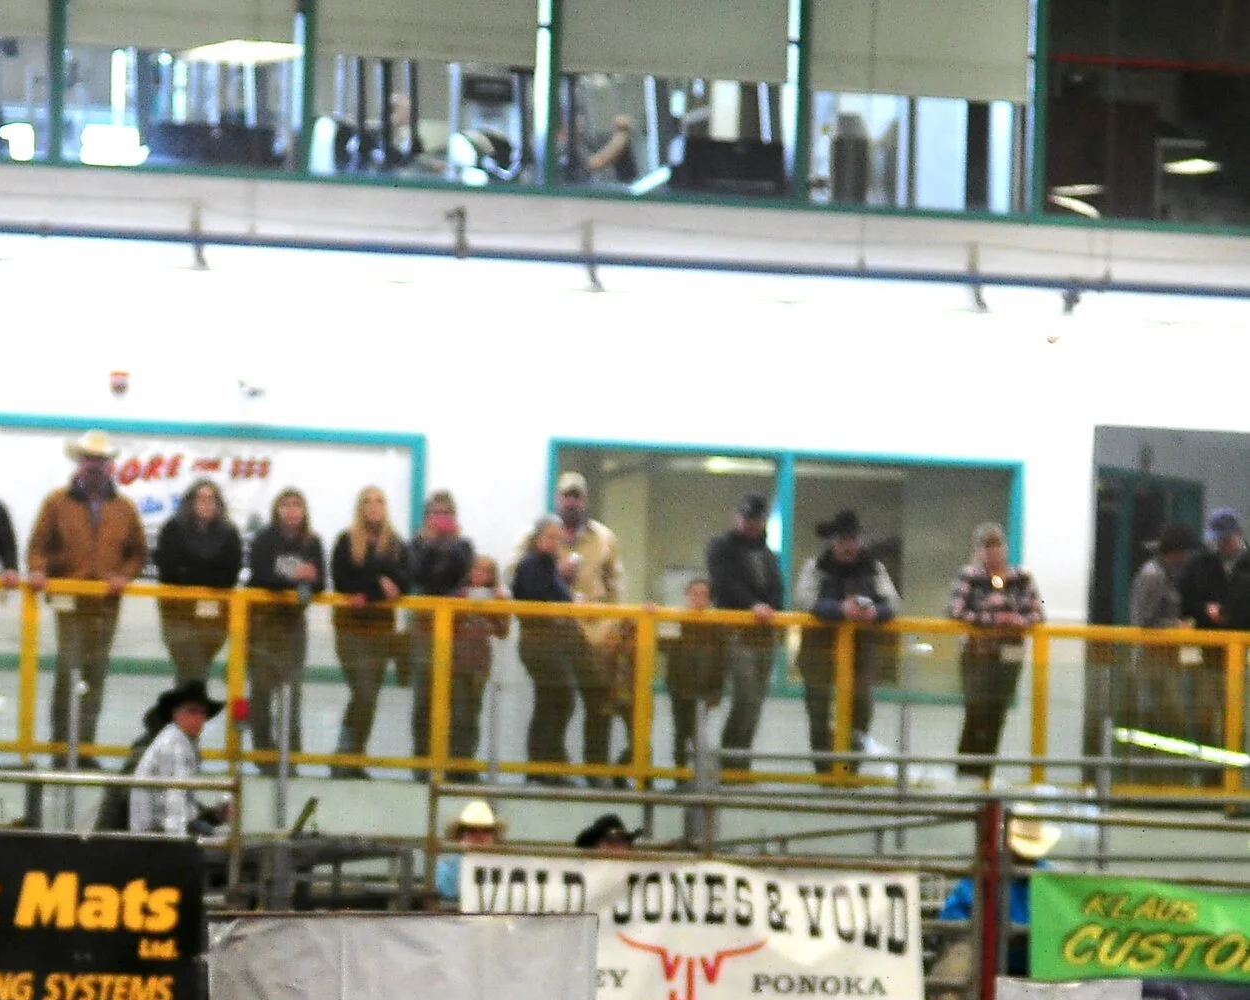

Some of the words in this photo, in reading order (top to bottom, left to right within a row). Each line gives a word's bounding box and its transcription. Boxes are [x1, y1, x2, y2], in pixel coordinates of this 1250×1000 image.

[14, 870, 181, 932] Mats
[613, 872, 753, 926] JONES
[798, 882, 911, 956] VOLD
[1082, 891, 1199, 924] KLAUS
[1061, 923, 1250, 974] CUSTO
[752, 972, 887, 997] PONOKA
